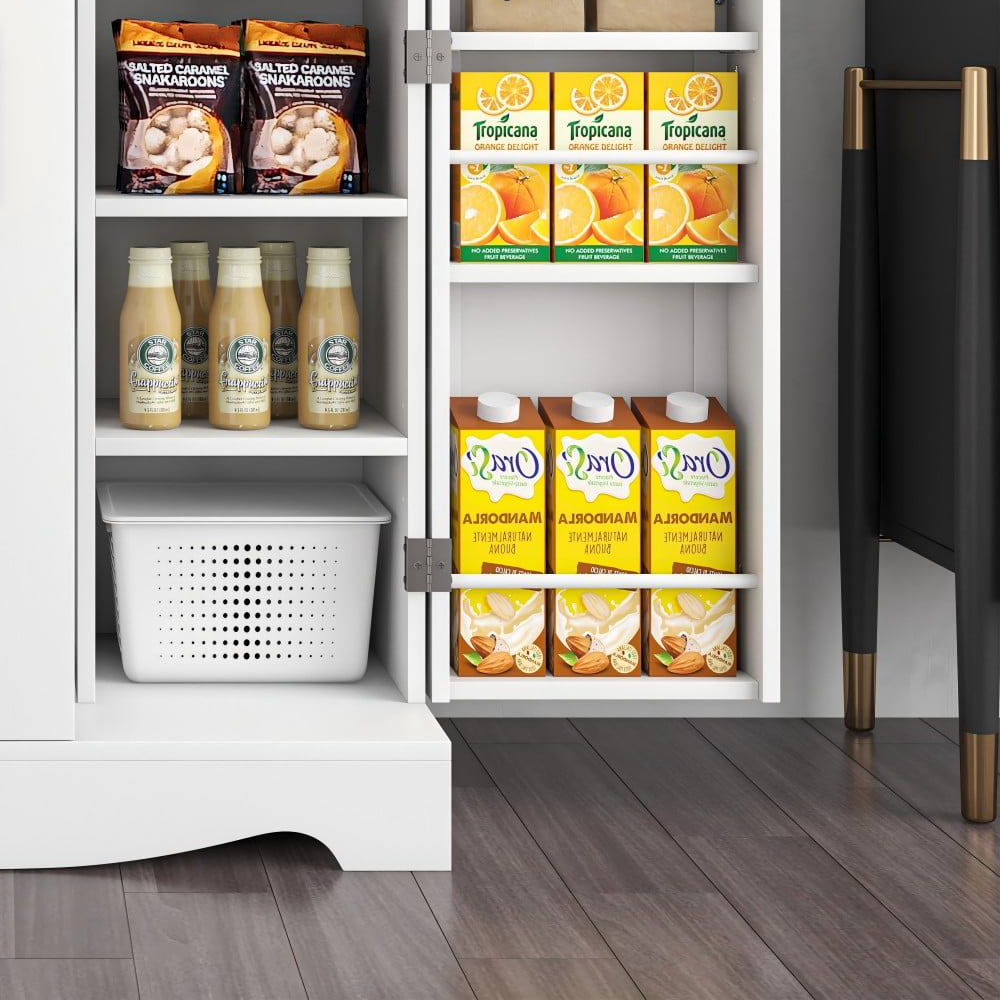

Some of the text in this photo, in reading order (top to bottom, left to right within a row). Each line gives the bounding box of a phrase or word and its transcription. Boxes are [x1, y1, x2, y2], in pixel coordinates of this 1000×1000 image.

[128, 62, 230, 76] SALTED CARAMEL
[253, 62, 355, 76] SALTED CARAMEL
[134, 73, 226, 88] SNAKAROONS
[259, 73, 351, 88] SNAKAROONS
[472, 120, 538, 141] Tropicana
[566, 120, 632, 141] Tropicana
[661, 120, 726, 141] Tropicana
[148, 338, 167, 346] STAR
[238, 338, 258, 346] STAR
[328, 338, 348, 346] STAR
